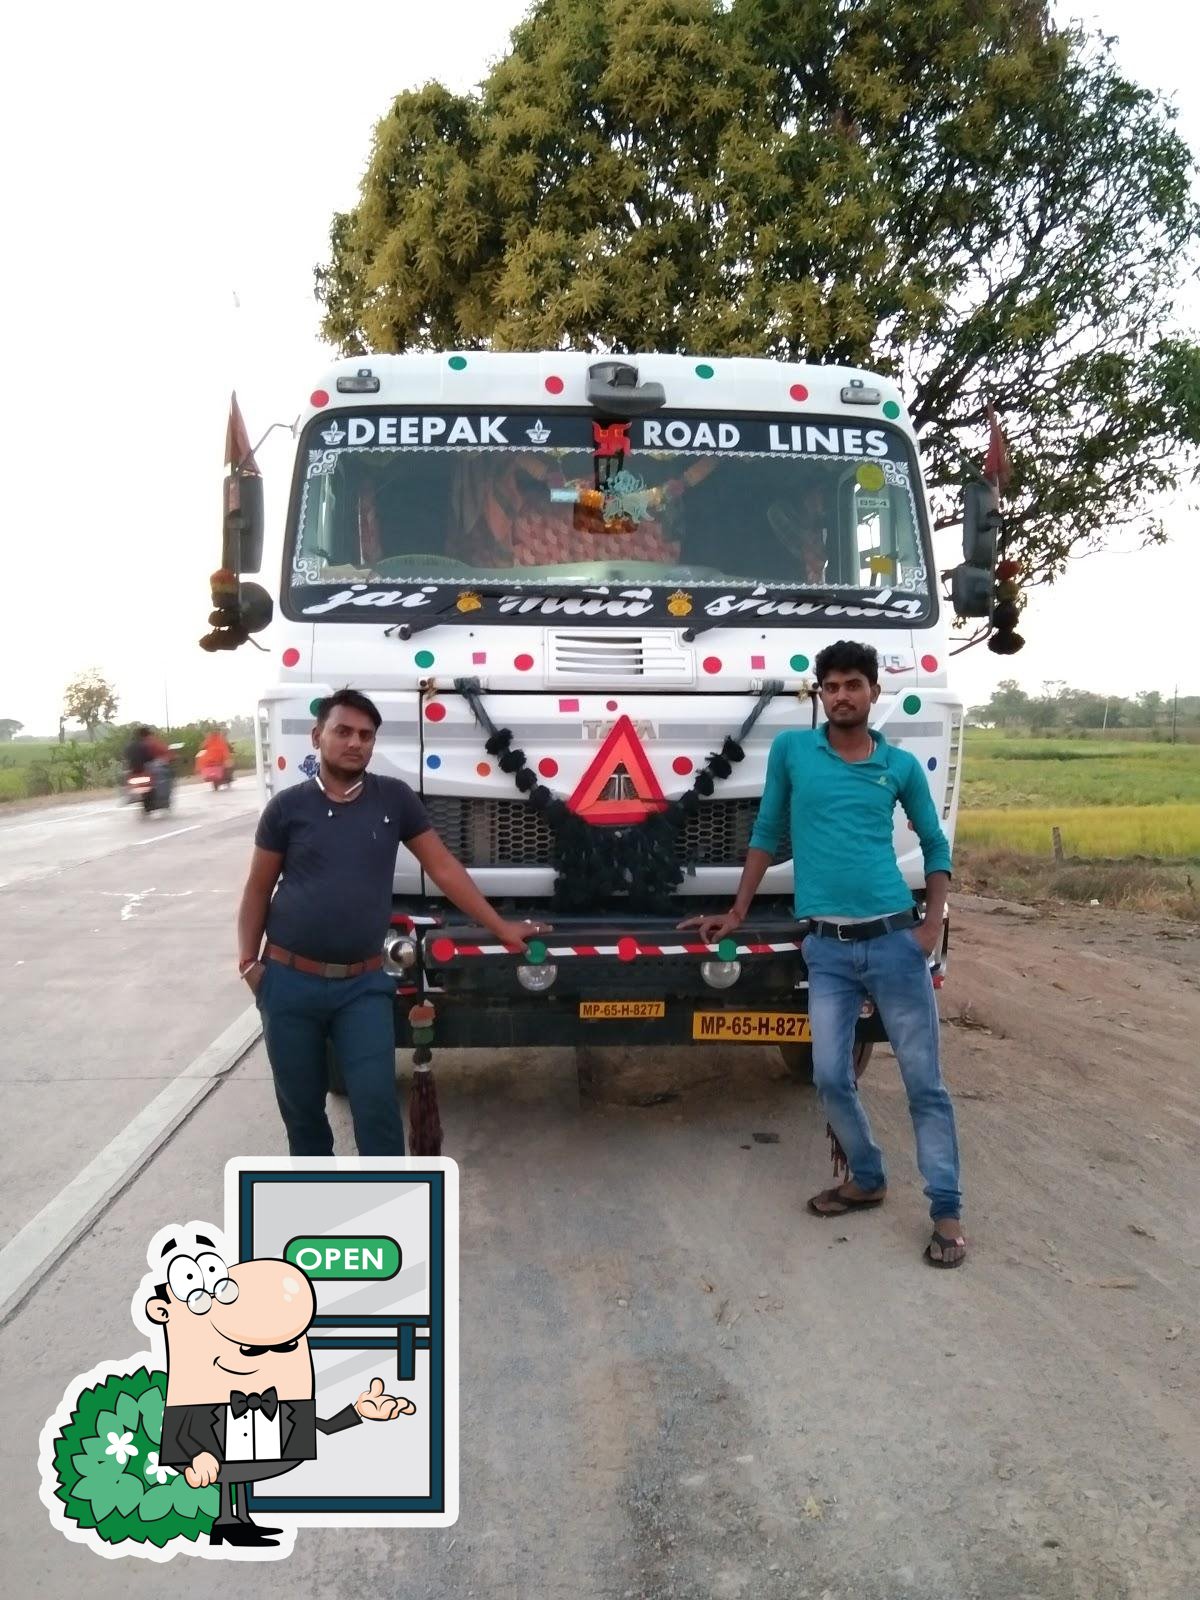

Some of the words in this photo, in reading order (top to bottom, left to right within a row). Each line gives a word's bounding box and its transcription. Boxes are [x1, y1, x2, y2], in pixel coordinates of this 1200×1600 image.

[348, 416, 509, 445] DEEPAK
[643, 420, 741, 449] ROAD
[769, 424, 888, 456] LINES
[301, 584, 438, 614] jai
[583, 719, 657, 740] TA
[583, 1003, 661, 1016] MP-65-H-8277
